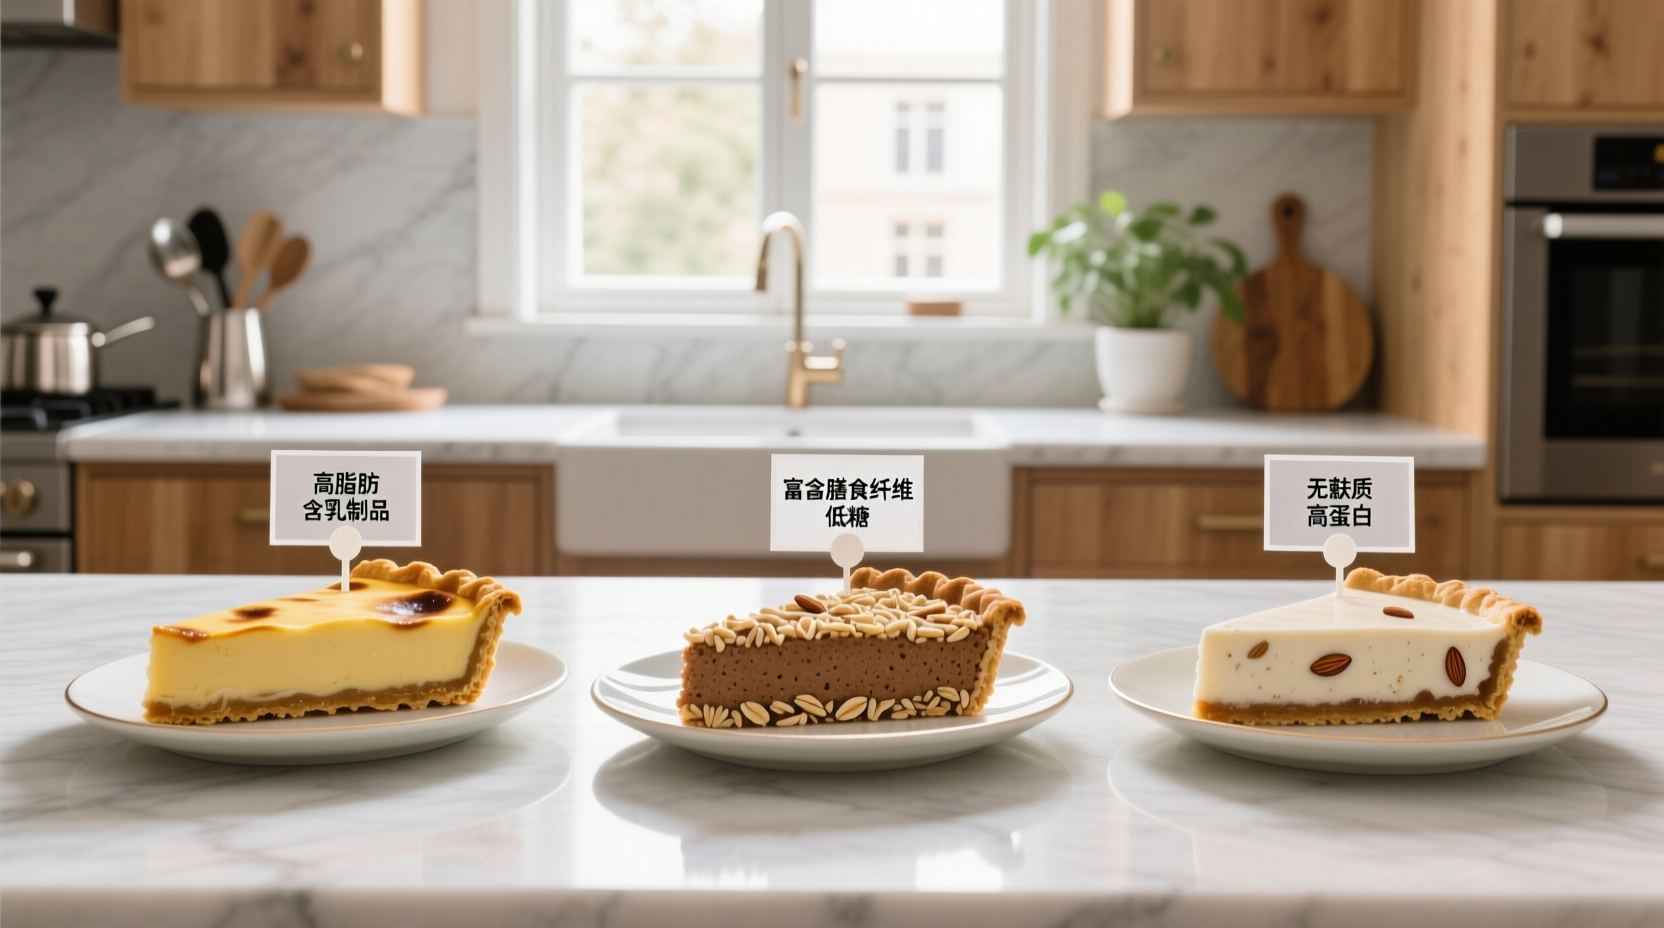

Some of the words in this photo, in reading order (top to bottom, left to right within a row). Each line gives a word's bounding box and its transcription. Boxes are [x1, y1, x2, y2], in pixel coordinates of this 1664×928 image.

[313, 472, 380, 495] 高脂肪
[783, 477, 914, 501] 富含膳食纤维
[303, 497, 390, 522] 含乳制品
[825, 505, 870, 528] 低糖
[1306, 503, 1372, 527] 高蛋白
